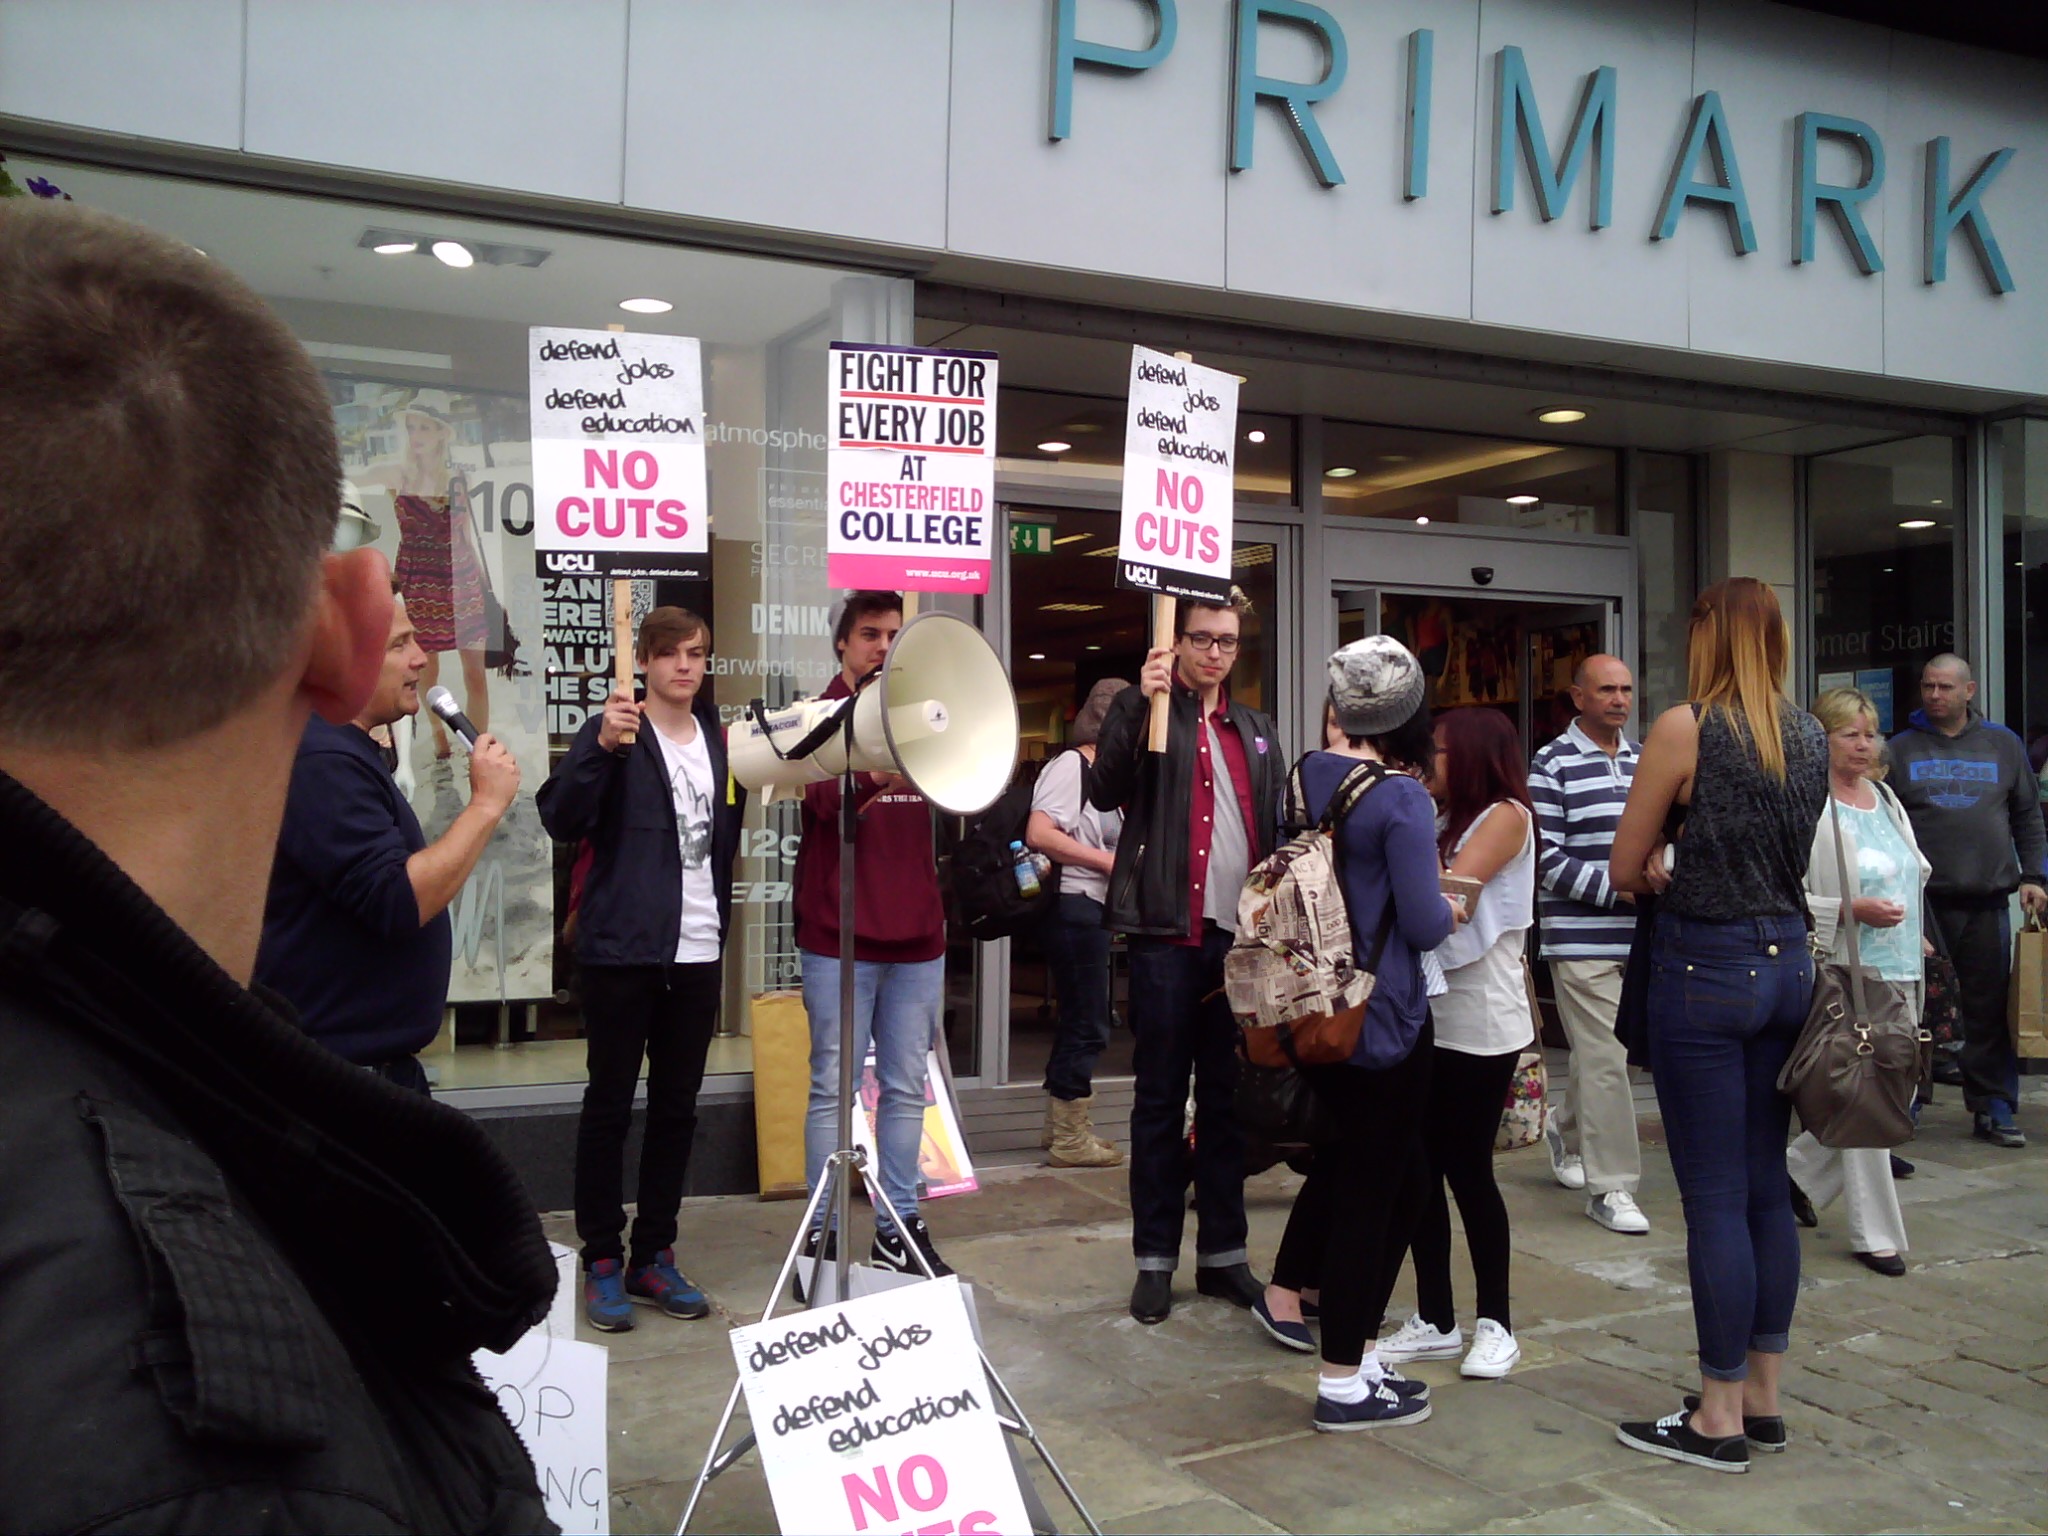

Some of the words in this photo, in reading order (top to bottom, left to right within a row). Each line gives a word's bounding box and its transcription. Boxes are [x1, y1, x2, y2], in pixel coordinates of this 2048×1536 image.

[1048, 0, 2017, 294] PRIMARK
[540, 338, 620, 362] defend
[617, 357, 674, 385] jobs
[840, 352, 923, 393] FIGHT
[933, 358, 985, 398] FOR
[1137, 360, 1187, 387] defend
[545, 388, 626, 410] defend
[1183, 388, 1220, 413] jobs
[581, 412, 695, 435] education
[839, 402, 927, 443] EVERY
[935, 408, 985, 446] JOB
[1137, 406, 1187, 434] defend
[900, 455, 926, 481] AT
[1158, 436, 1229, 466] education
[584, 448, 659, 490] NO
[840, 481, 983, 513] CHESTERFIELD
[1156, 467, 1204, 514] NO
[555, 496, 688, 539] CUTS
[840, 510, 982, 546] COLLEGE
[1135, 512, 1220, 564] CUTS
[752, 603, 829, 636] DENIM
[1881, 620, 1955, 651] Stairs
[704, 653, 842, 678] darwoodstat
[731, 882, 793, 904] EB
[750, 1312, 856, 1372] defend
[858, 1324, 932, 1370] jobs
[484, 1378, 574, 1436] OP
[773, 1378, 881, 1436] defend
[828, 1389, 981, 1453] education
[841, 1454, 948, 1531] NO
